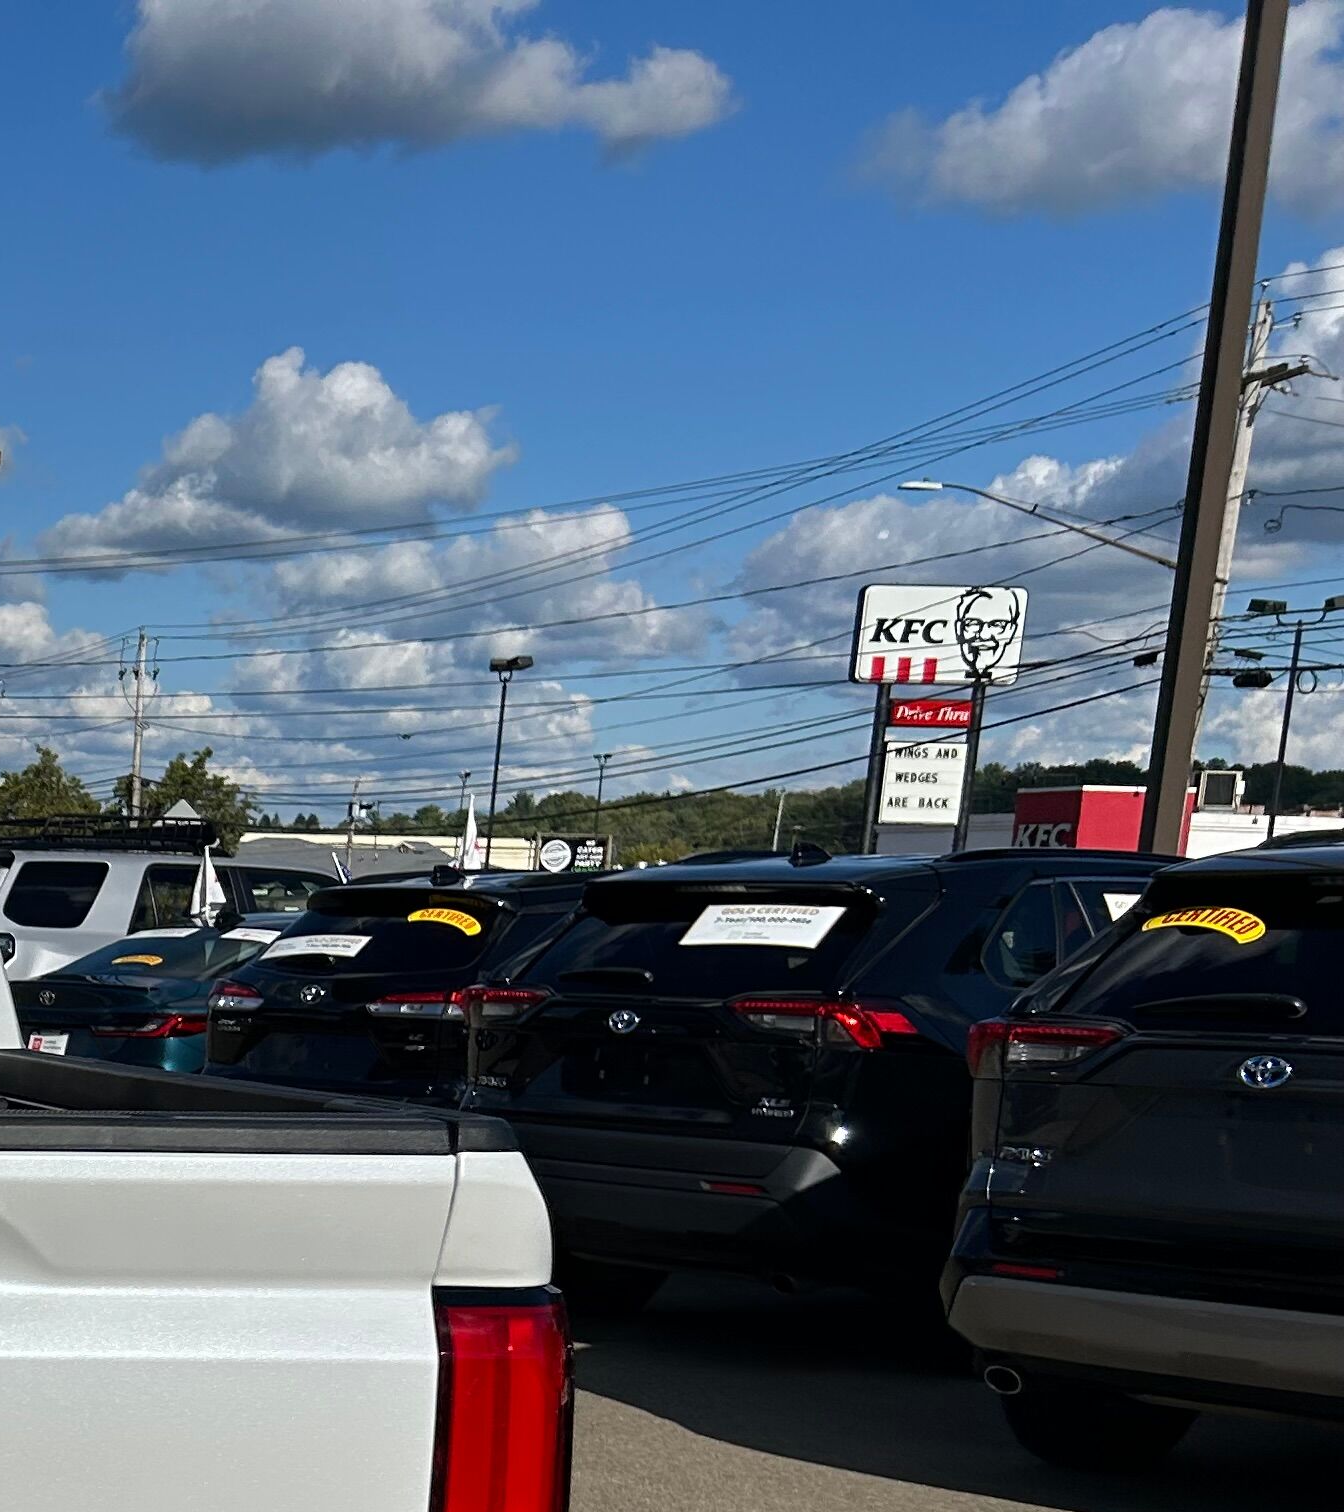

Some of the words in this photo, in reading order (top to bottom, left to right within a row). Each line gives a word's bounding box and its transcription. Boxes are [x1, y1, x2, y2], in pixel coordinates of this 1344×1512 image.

[869, 618, 948, 644] KFC
[896, 705, 933, 720] Drive
[937, 706, 970, 721] Thru
[895, 747, 929, 759] WINGS
[935, 748, 958, 759] AND
[895, 772, 939, 784] WEDGES
[887, 797, 909, 809] ARE
[918, 797, 949, 809] BACK
[1014, 823, 1072, 848] KFC
[1162, 908, 1260, 935] CERTIFIED
